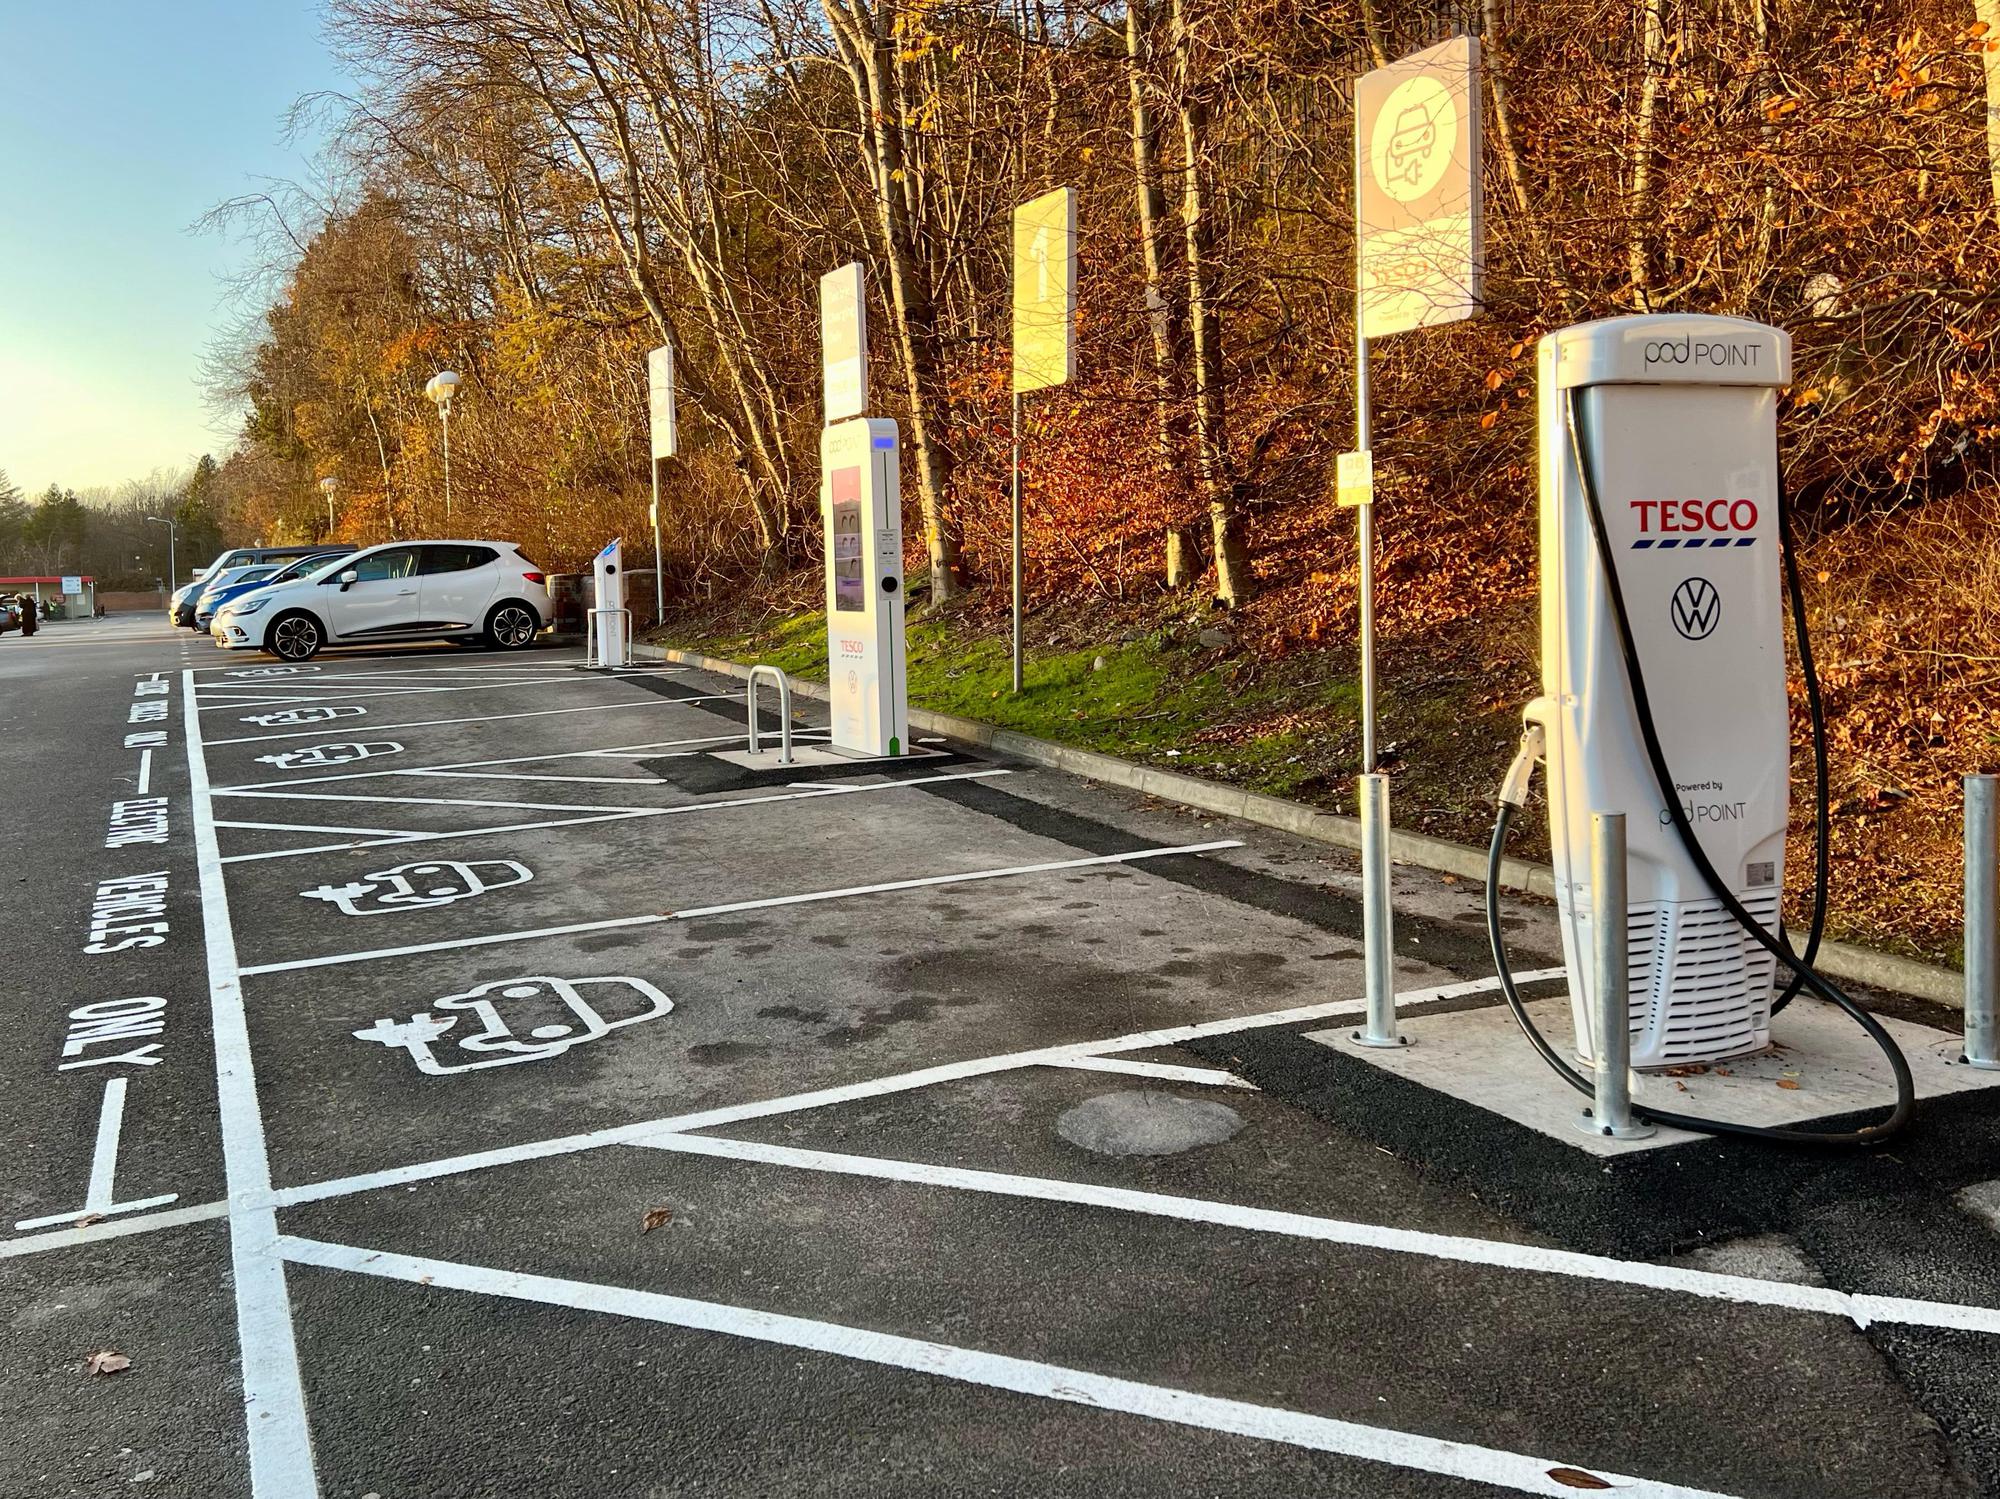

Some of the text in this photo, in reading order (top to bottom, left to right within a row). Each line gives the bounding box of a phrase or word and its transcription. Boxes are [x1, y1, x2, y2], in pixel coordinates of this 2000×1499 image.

[1644, 333, 1761, 372] pod POINT
[1630, 499, 1758, 532] TESCO
[840, 640, 864, 653] TESCO
[1675, 780, 1723, 792] Powered by
[105, 796, 169, 849] ELECTRIC
[1658, 800, 1747, 832] pd POINT
[83, 870, 171, 956] VEHICLES
[58, 996, 168, 1071] ONLY
